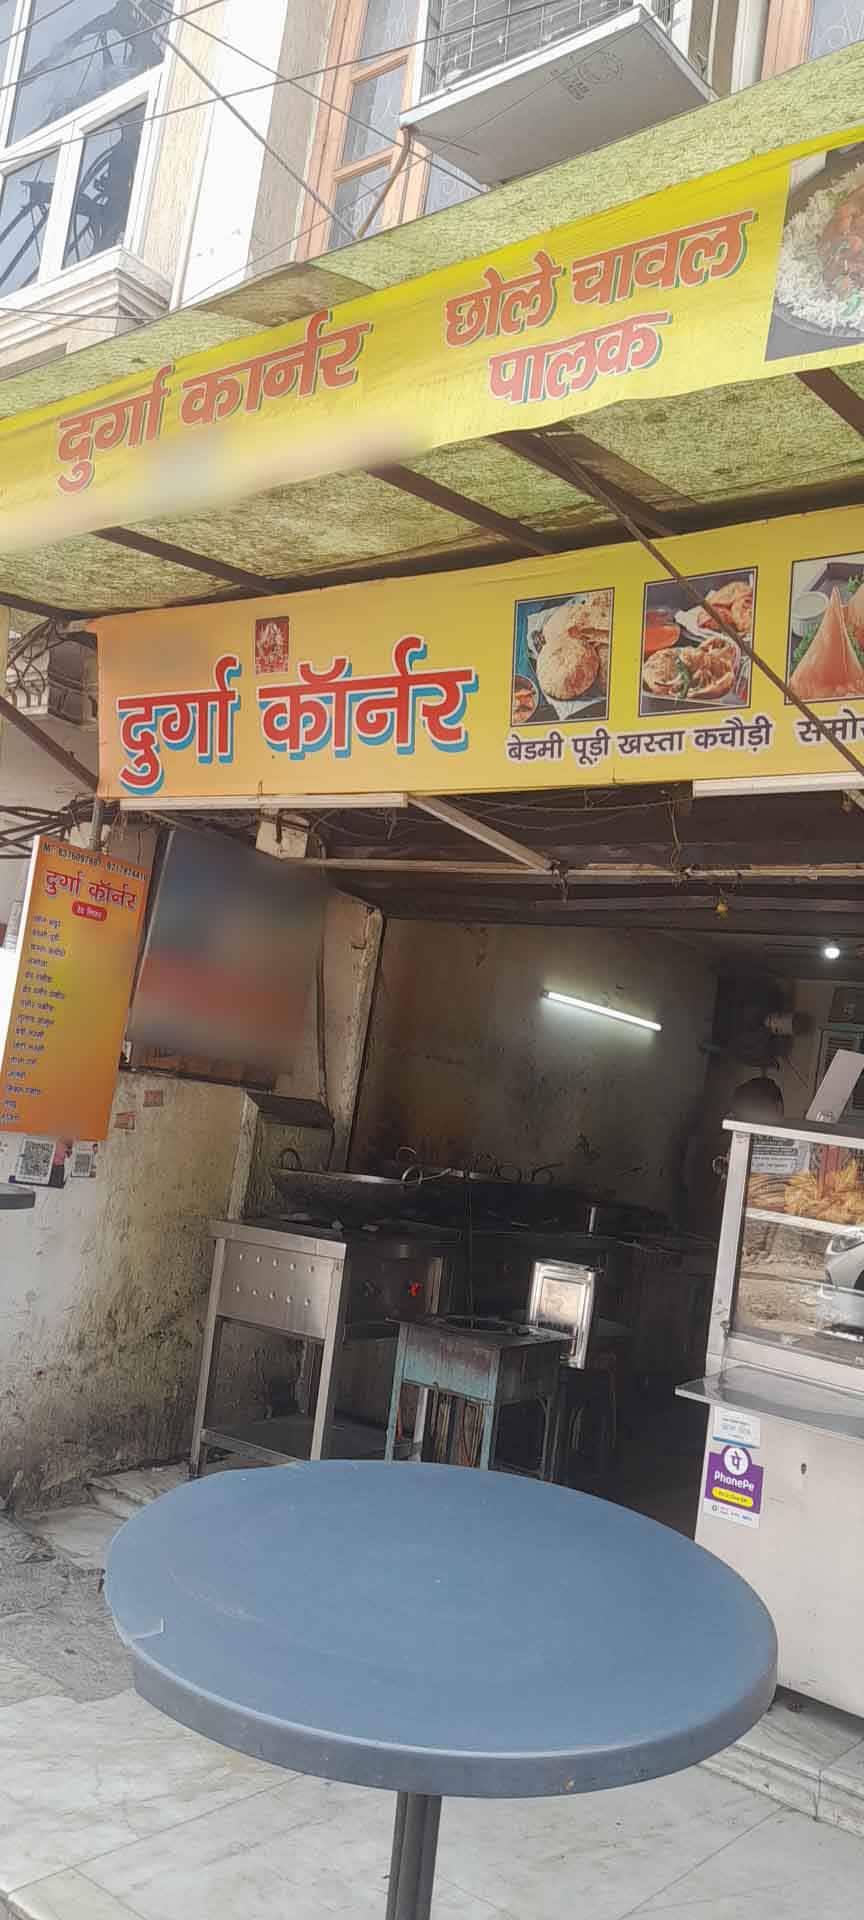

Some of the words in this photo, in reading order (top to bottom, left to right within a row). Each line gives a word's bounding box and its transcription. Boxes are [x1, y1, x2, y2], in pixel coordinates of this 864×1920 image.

[441, 245, 563, 349] छोले
[570, 209, 757, 306] चावल
[56, 359, 176, 495] दुर्गा
[180, 309, 373, 425] कार्नर
[487, 310, 673, 405] पालक
[117, 655, 240, 795] दुर्गा
[255, 636, 479, 761] कॉर्नर
[507, 732, 563, 762] बेडमी
[571, 728, 611, 765] पूड़ी
[617, 730, 686, 756] खस्ता
[693, 716, 773, 753] कचौड़ी
[798, 709, 864, 743] समो
[46, 869, 85, 898] दुर्गा
[88, 879, 137, 911] कॉर्नर
[714, 1470, 754, 1492] PhonePe
